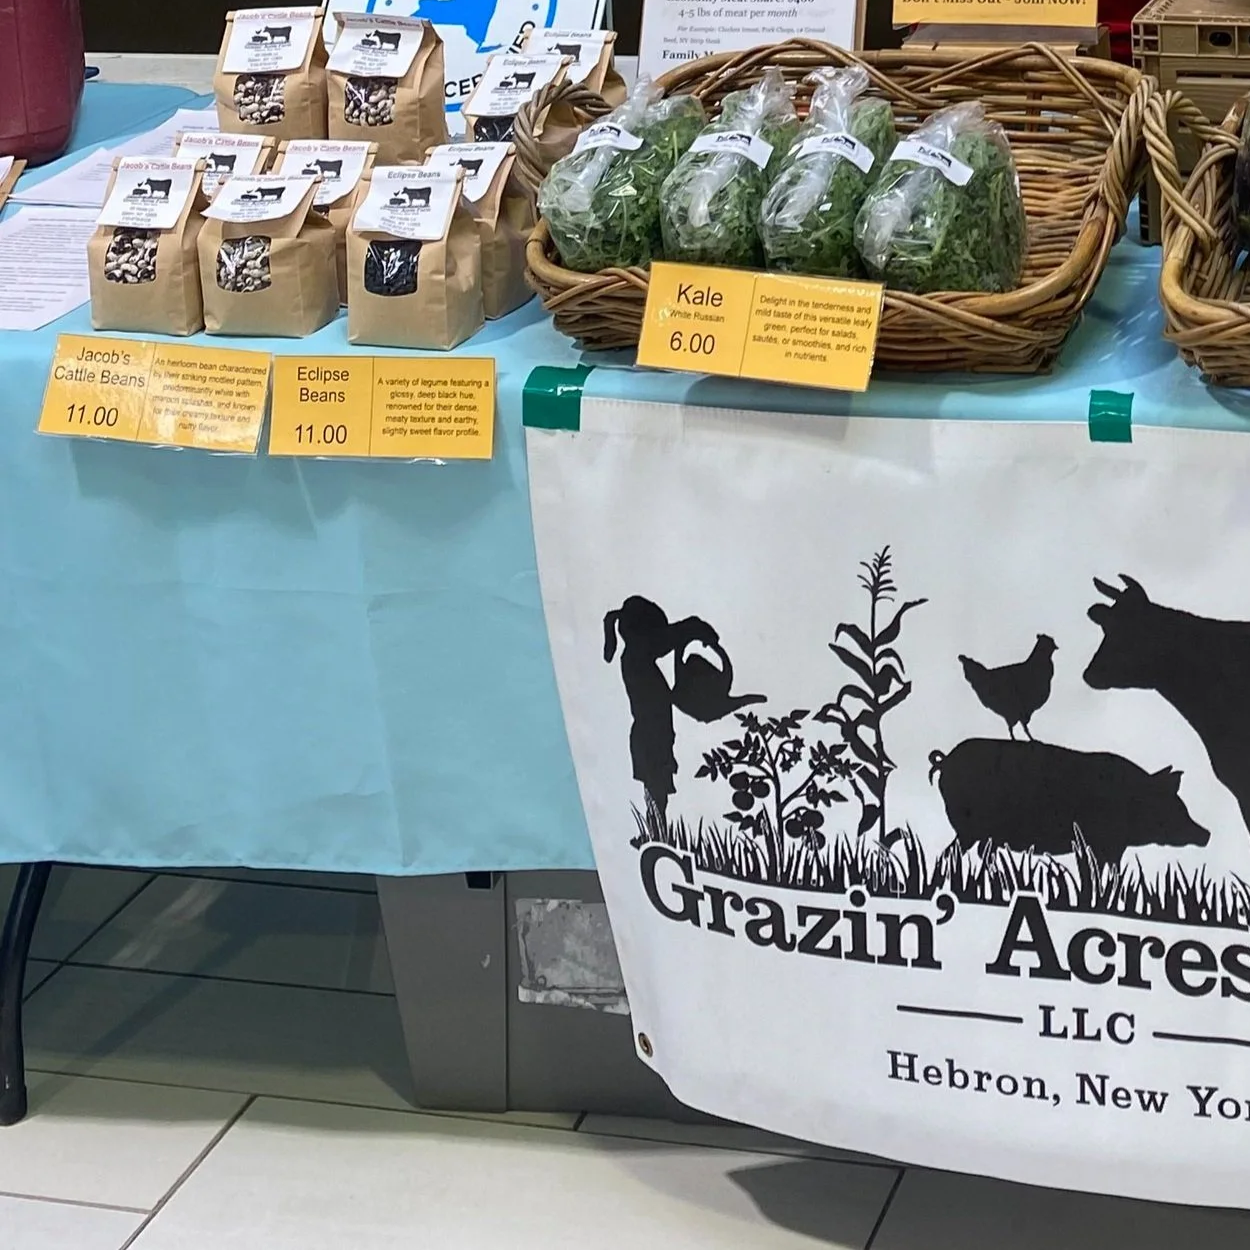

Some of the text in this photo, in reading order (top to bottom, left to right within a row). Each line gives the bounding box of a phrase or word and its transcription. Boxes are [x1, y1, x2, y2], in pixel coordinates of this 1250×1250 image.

[678, 8, 798, 19] 4-5 lbs of meat per month
[662, 50, 700, 60] Family
[121, 162, 149, 170] Jacob's
[151, 162, 171, 170] Cattle
[388, 171, 416, 179] Eclipse
[677, 283, 723, 307] Kale
[760, 295, 871, 314] Delight in the tenderness and
[670, 309, 725, 323] White Russian
[755, 308, 872, 329] mild taste of this versatile leafy
[670, 331, 715, 355] 6.00
[77, 347, 130, 365] Jacob's
[166, 358, 266, 375] heirloom bean characterized
[298, 367, 350, 384] Eclipse
[55, 366, 145, 388] Cattle Beans
[385, 379, 410, 387] variety
[421, 379, 447, 388] legume
[450, 379, 483, 388] featuring
[300, 388, 345, 402] Beans
[67, 404, 119, 427] 11.00
[386, 403, 422, 411] renowned
[295, 425, 348, 444] 11.00
[638, 840, 956, 971] Grazin'
[1038, 1004, 1138, 1046] LLC
[886, 1049, 1063, 1108] Hebron,
[1076, 1072, 1169, 1115] New
